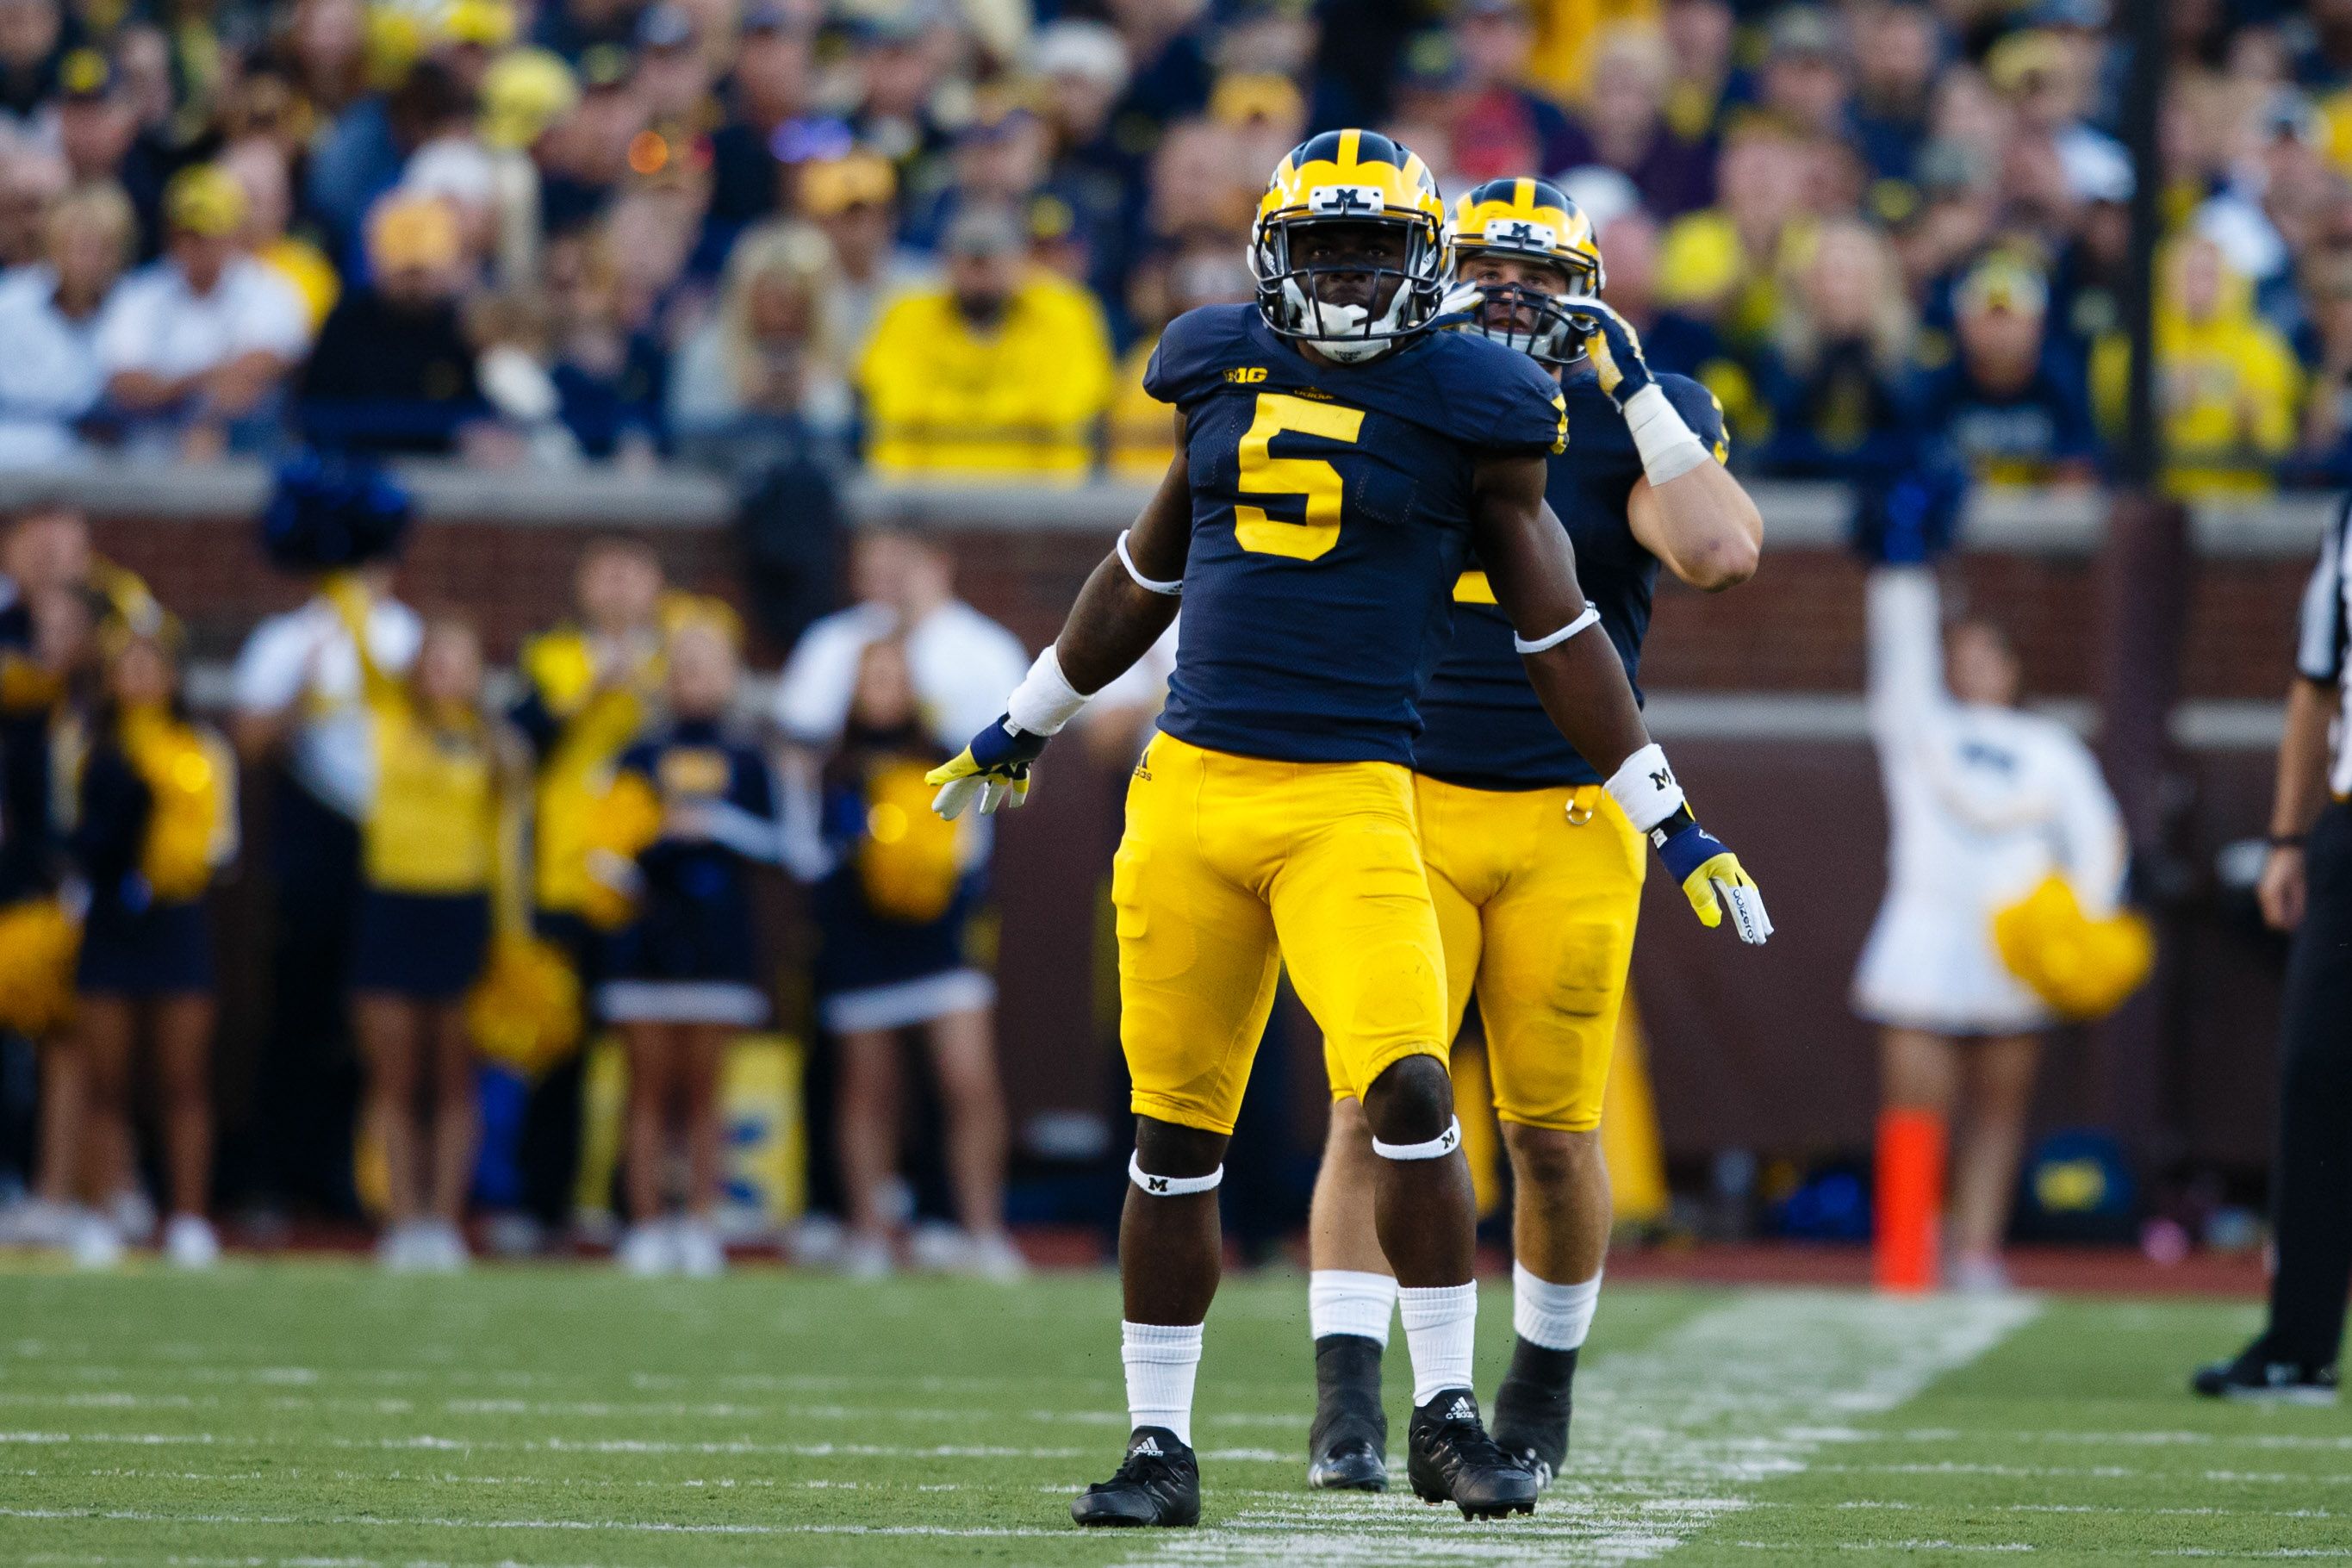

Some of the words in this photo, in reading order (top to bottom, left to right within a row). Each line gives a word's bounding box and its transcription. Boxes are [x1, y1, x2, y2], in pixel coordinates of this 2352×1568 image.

[1235, 392, 1366, 562] 5
[1649, 768, 1672, 791] M
[1733, 888, 1754, 939] adizero
[1440, 1130, 1455, 1149] M
[1148, 1176, 1168, 1192] M
